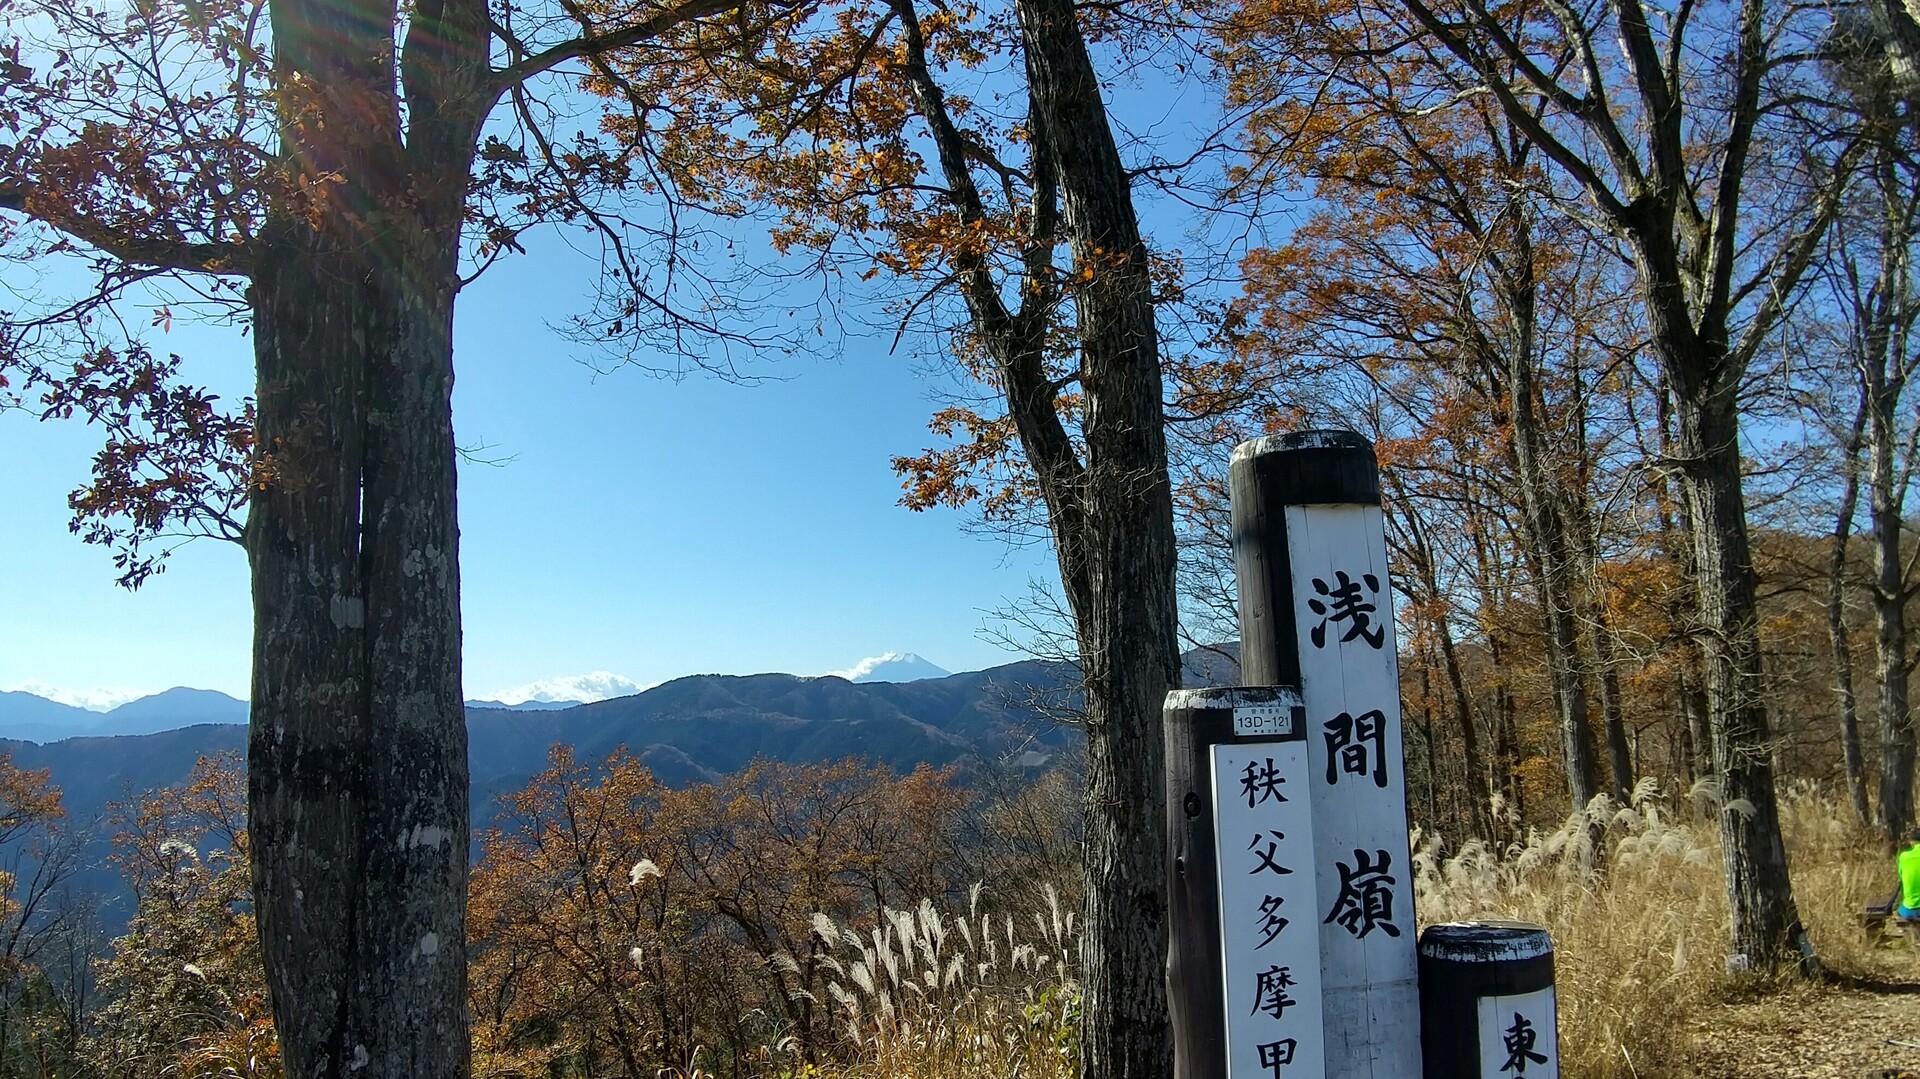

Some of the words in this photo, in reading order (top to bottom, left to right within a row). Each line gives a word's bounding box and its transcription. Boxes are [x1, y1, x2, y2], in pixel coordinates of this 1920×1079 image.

[1238, 716, 1289, 728] 13D-121
[1307, 570, 1401, 941] 浅間嶺
[1239, 757, 1298, 1079] 秩父多摩甲
[1499, 1011, 1549, 1079] 東
